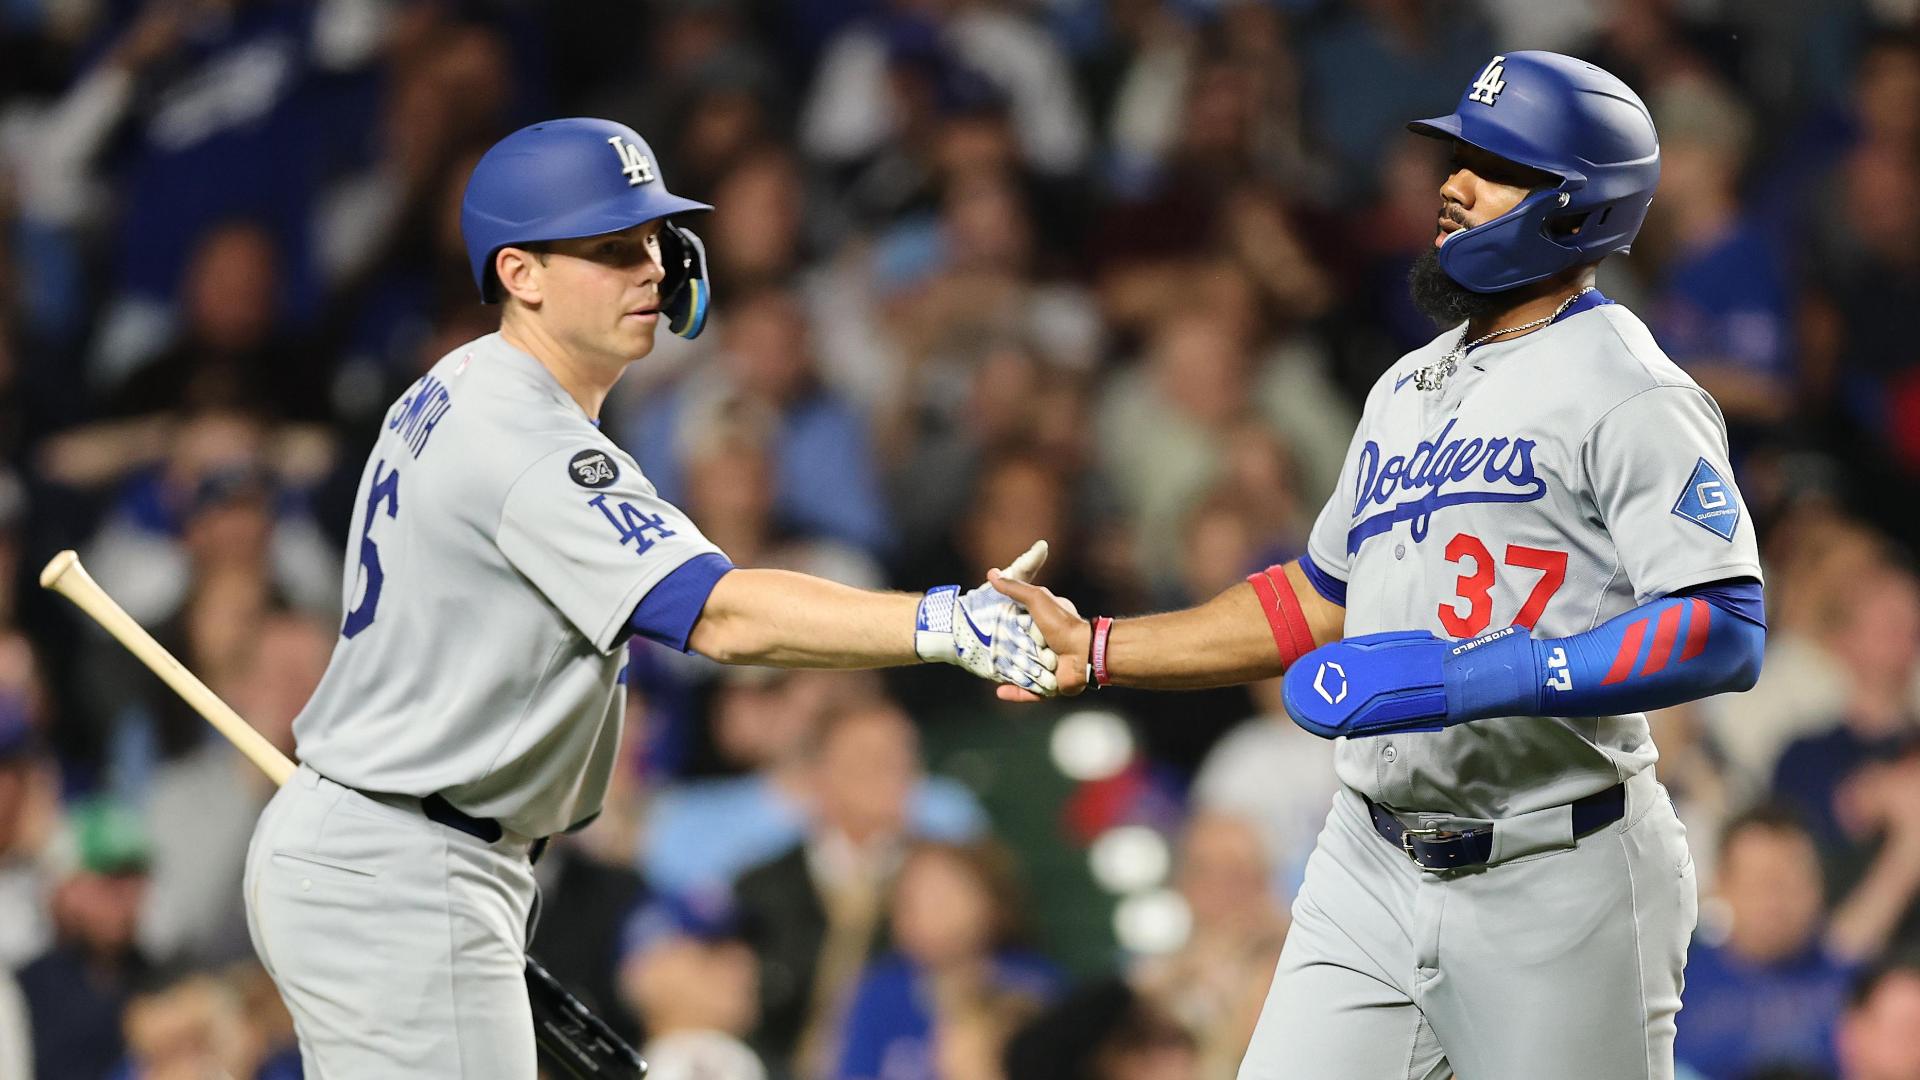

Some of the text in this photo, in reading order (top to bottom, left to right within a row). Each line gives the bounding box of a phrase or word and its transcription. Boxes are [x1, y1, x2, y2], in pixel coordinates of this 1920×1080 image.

[1468, 55, 1507, 107] LA
[607, 135, 655, 186] LA
[388, 374, 451, 459] SMITH
[578, 460, 615, 485] 34
[1350, 417, 1547, 544] Dodgers
[1696, 481, 1727, 509] G
[587, 493, 677, 556] LA
[1437, 532, 1569, 639] 37
